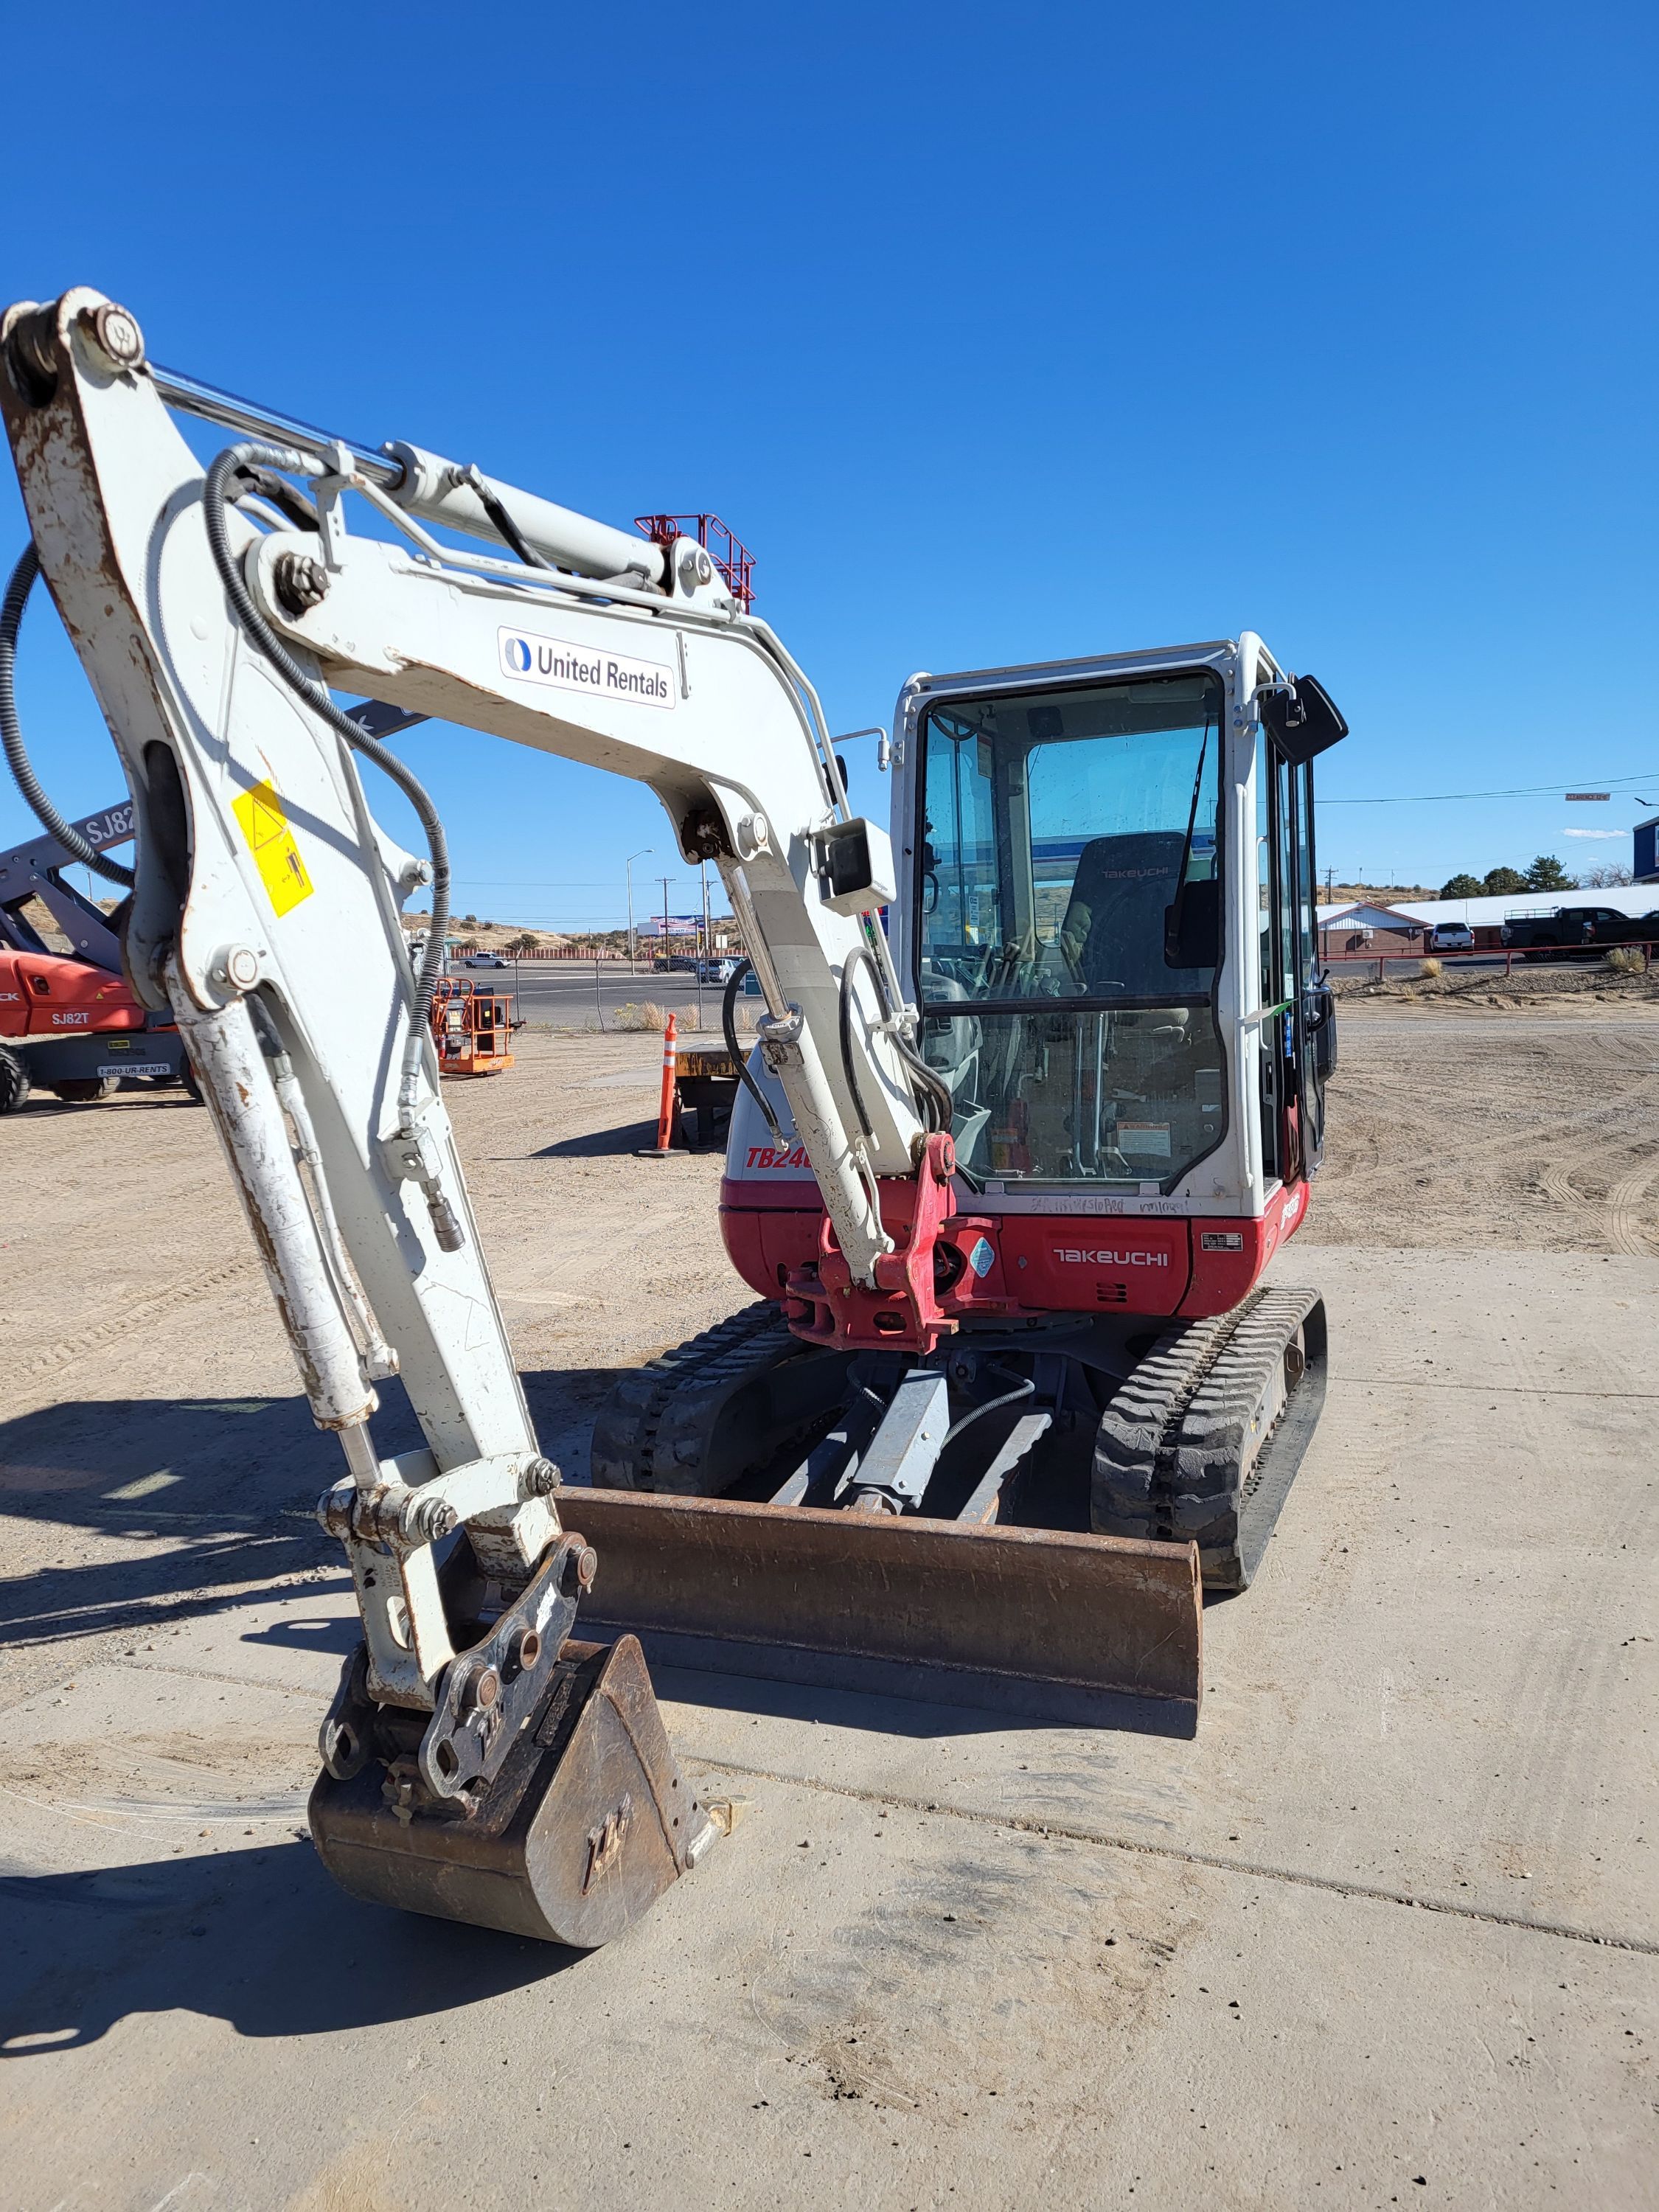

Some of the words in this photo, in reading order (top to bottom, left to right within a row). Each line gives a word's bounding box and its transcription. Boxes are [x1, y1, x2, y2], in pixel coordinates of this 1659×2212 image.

[538, 646, 601, 685] United
[607, 661, 667, 698] Rentals
[52, 1012, 89, 1025] SJ82T
[100, 1065, 168, 1076] 1-800-UR-RENTS
